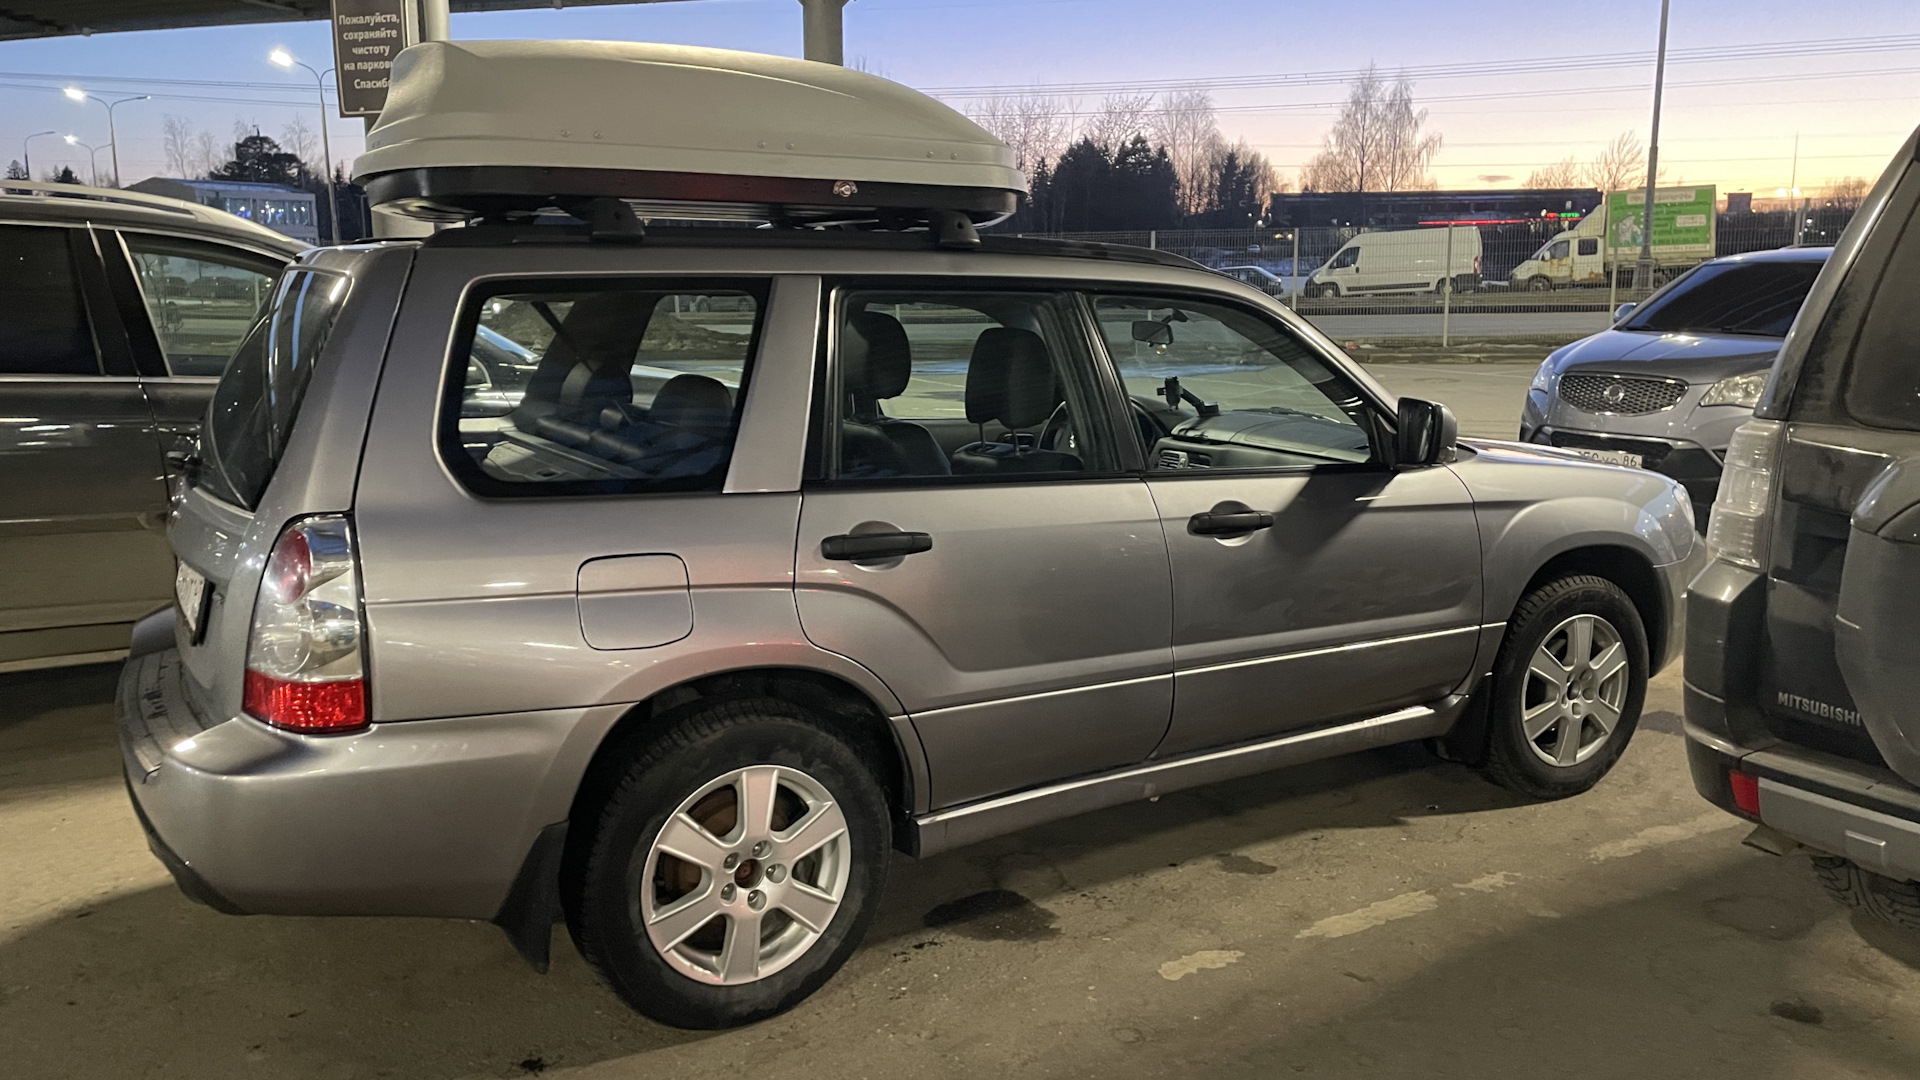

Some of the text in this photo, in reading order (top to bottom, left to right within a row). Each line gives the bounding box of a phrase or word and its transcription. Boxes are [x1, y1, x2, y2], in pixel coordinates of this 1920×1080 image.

[338, 12, 400, 26] Пожалуйста,
[343, 27, 398, 42] сохраняйте
[352, 45, 390, 56] чистоту
[343, 61, 355, 71] на
[1777, 691, 1860, 727] MITSUBISHI
